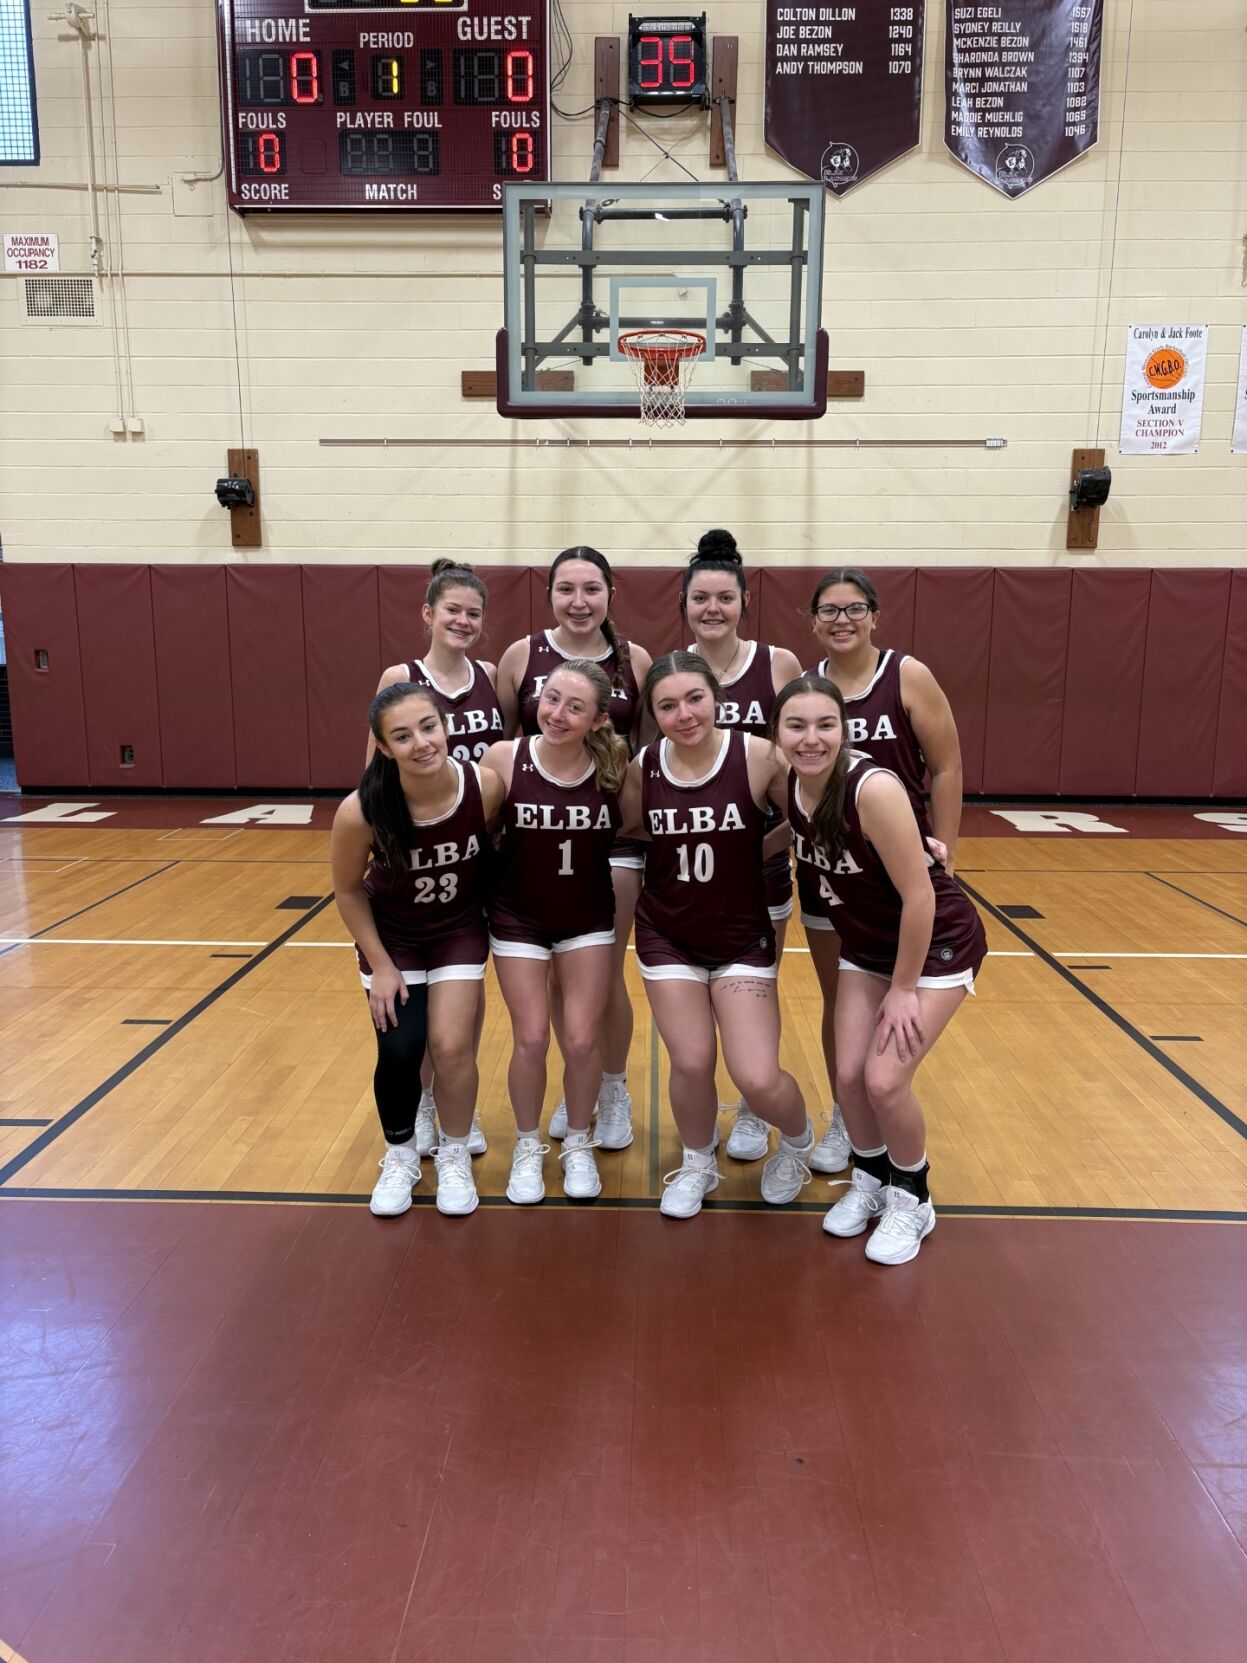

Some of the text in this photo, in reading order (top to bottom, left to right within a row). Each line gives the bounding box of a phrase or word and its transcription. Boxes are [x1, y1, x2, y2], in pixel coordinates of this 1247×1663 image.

[777, 7, 914, 21] COLTON DILLON 1338
[954, 8, 974, 18] SUZI
[977, 7, 1001, 18] EGELI
[246, 18, 311, 42] HOME
[457, 16, 531, 41] GUEST
[776, 25, 912, 39] JOE BEZON 1240
[954, 22, 989, 34] SYDNEY
[992, 22, 1021, 33] REILLY
[360, 32, 414, 48] PERIOD
[953, 37, 1087, 48] MCKENZIE BEZON 1461
[776, 43, 912, 56] DAN RAMSEY 1164
[953, 51, 1089, 63] SHARONDA BROWN 1394
[640, 35, 694, 88] 35
[776, 61, 911, 74] ANDY THOMPSON 1070
[291, 51, 319, 104] 0
[391, 59, 399, 95] 1
[507, 51, 533, 102] 0
[953, 67, 1085, 78] BRYNN WALCZAK 1107
[952, 82, 1085, 93] MARCI JONATHAN 1103
[952, 96, 973, 107] LEAH
[975, 96, 1004, 107] BEZON
[238, 112, 286, 128] FOULS
[337, 112, 443, 128] PLAYER FOUL
[492, 111, 540, 128] FOULS
[951, 111, 983, 122] MADDIE
[985, 111, 1023, 122] MUEHLIG
[951, 125, 1086, 137] EMILY REYNOLDS 1046
[258, 133, 280, 172] 0
[512, 133, 533, 172] 0
[240, 184, 289, 200] SCORE
[365, 184, 417, 200] MATCH
[11, 236, 50, 246] MAXIMUM
[7, 248, 55, 258] OCCUPANCY
[16, 259, 48, 269] 1182
[1133, 327, 1203, 341] Carolyn & Jack Foote
[1131, 389, 1196, 404] Sportsmanship
[1148, 404, 1177, 415] Award
[1136, 419, 1185, 428] SECTION V
[1135, 428, 1184, 437] CHAMPION
[1150, 441, 1167, 450] 2012
[716, 700, 766, 725] BA
[445, 707, 504, 736] LBA
[846, 714, 897, 742] BA
[514, 802, 611, 830] ELBA
[648, 803, 746, 835] ELBA
[409, 834, 480, 871] LBA
[557, 839, 574, 876] 1
[790, 827, 864, 875] LBA
[676, 843, 714, 883] 10
[414, 872, 458, 904] 23
[819, 874, 846, 907] 4
